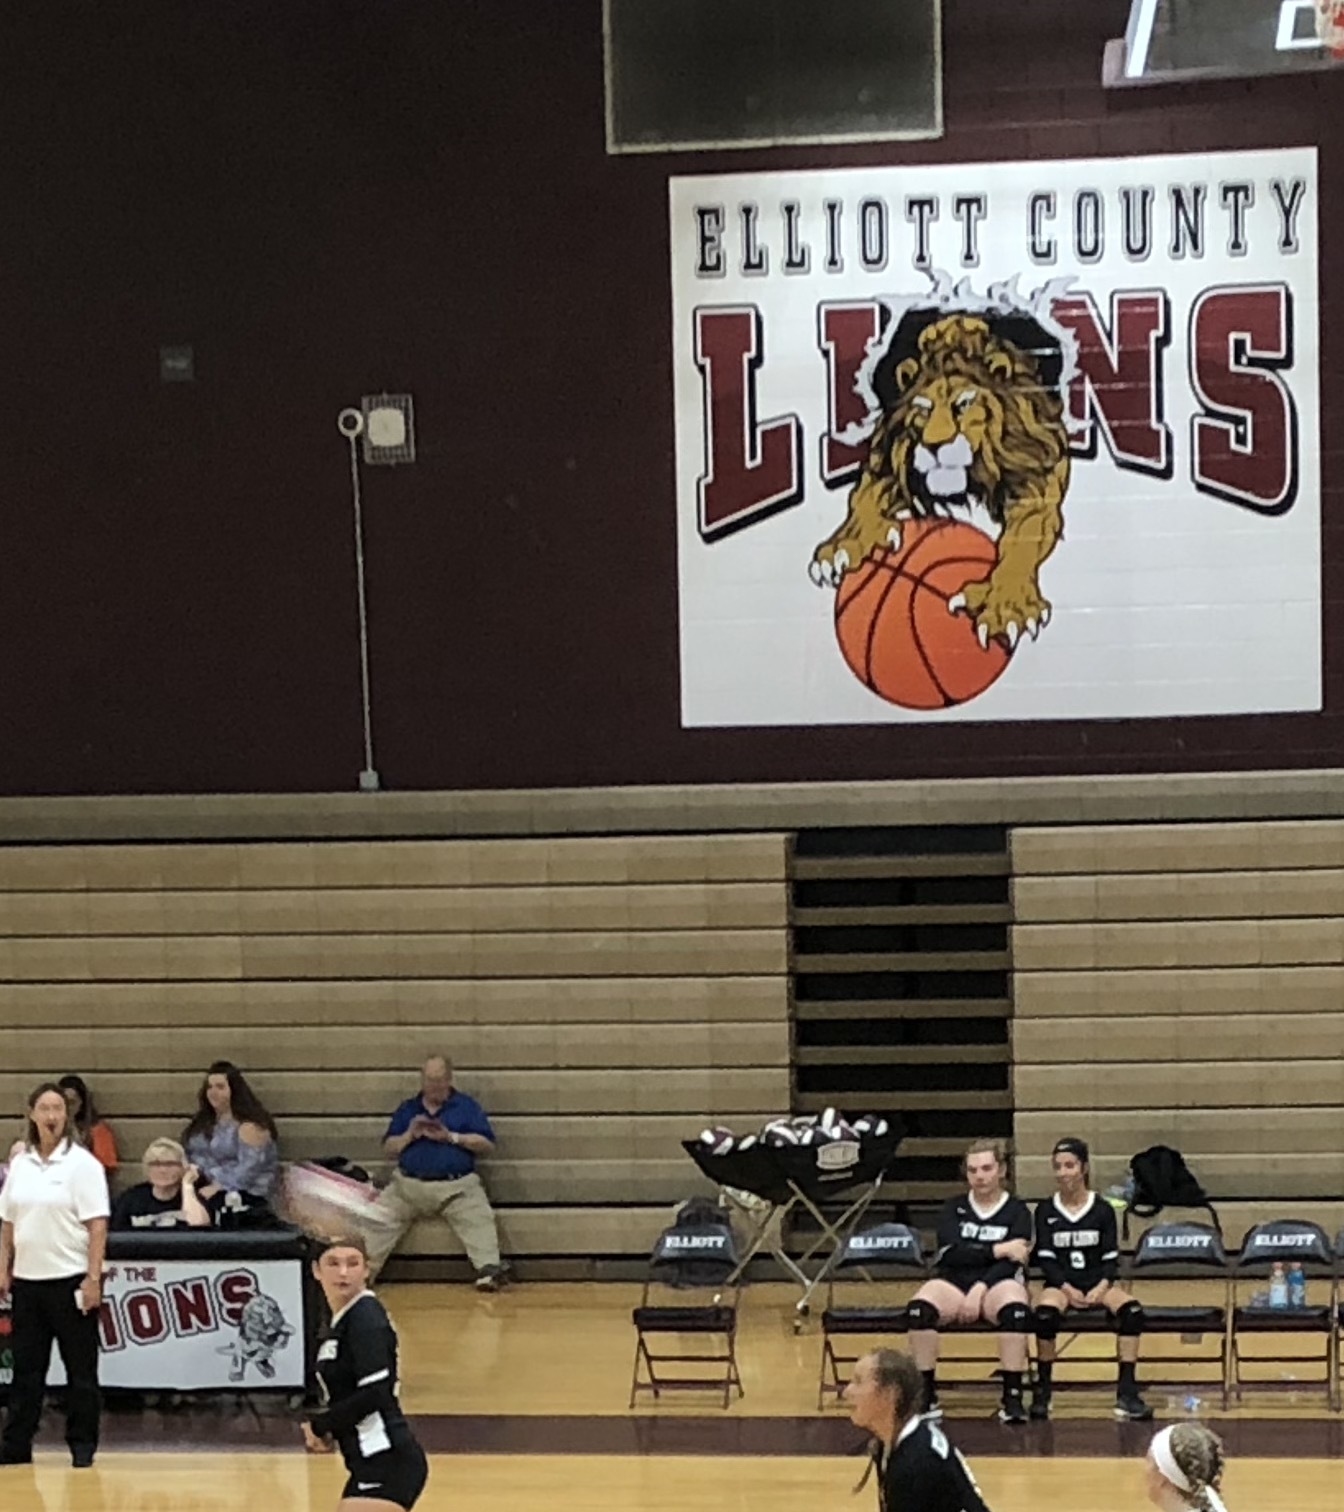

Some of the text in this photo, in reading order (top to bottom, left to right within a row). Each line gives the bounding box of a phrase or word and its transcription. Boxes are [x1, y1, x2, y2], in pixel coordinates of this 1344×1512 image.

[695, 179, 1306, 277] ELLIOTT COUNTY
[694, 282, 1300, 544] LINS
[1147, 1235, 1213, 1247] ELLIOTT
[1255, 1234, 1317, 1247] ELLIOTT
[124, 1267, 157, 1282] THE
[99, 1268, 260, 1353] IONS
